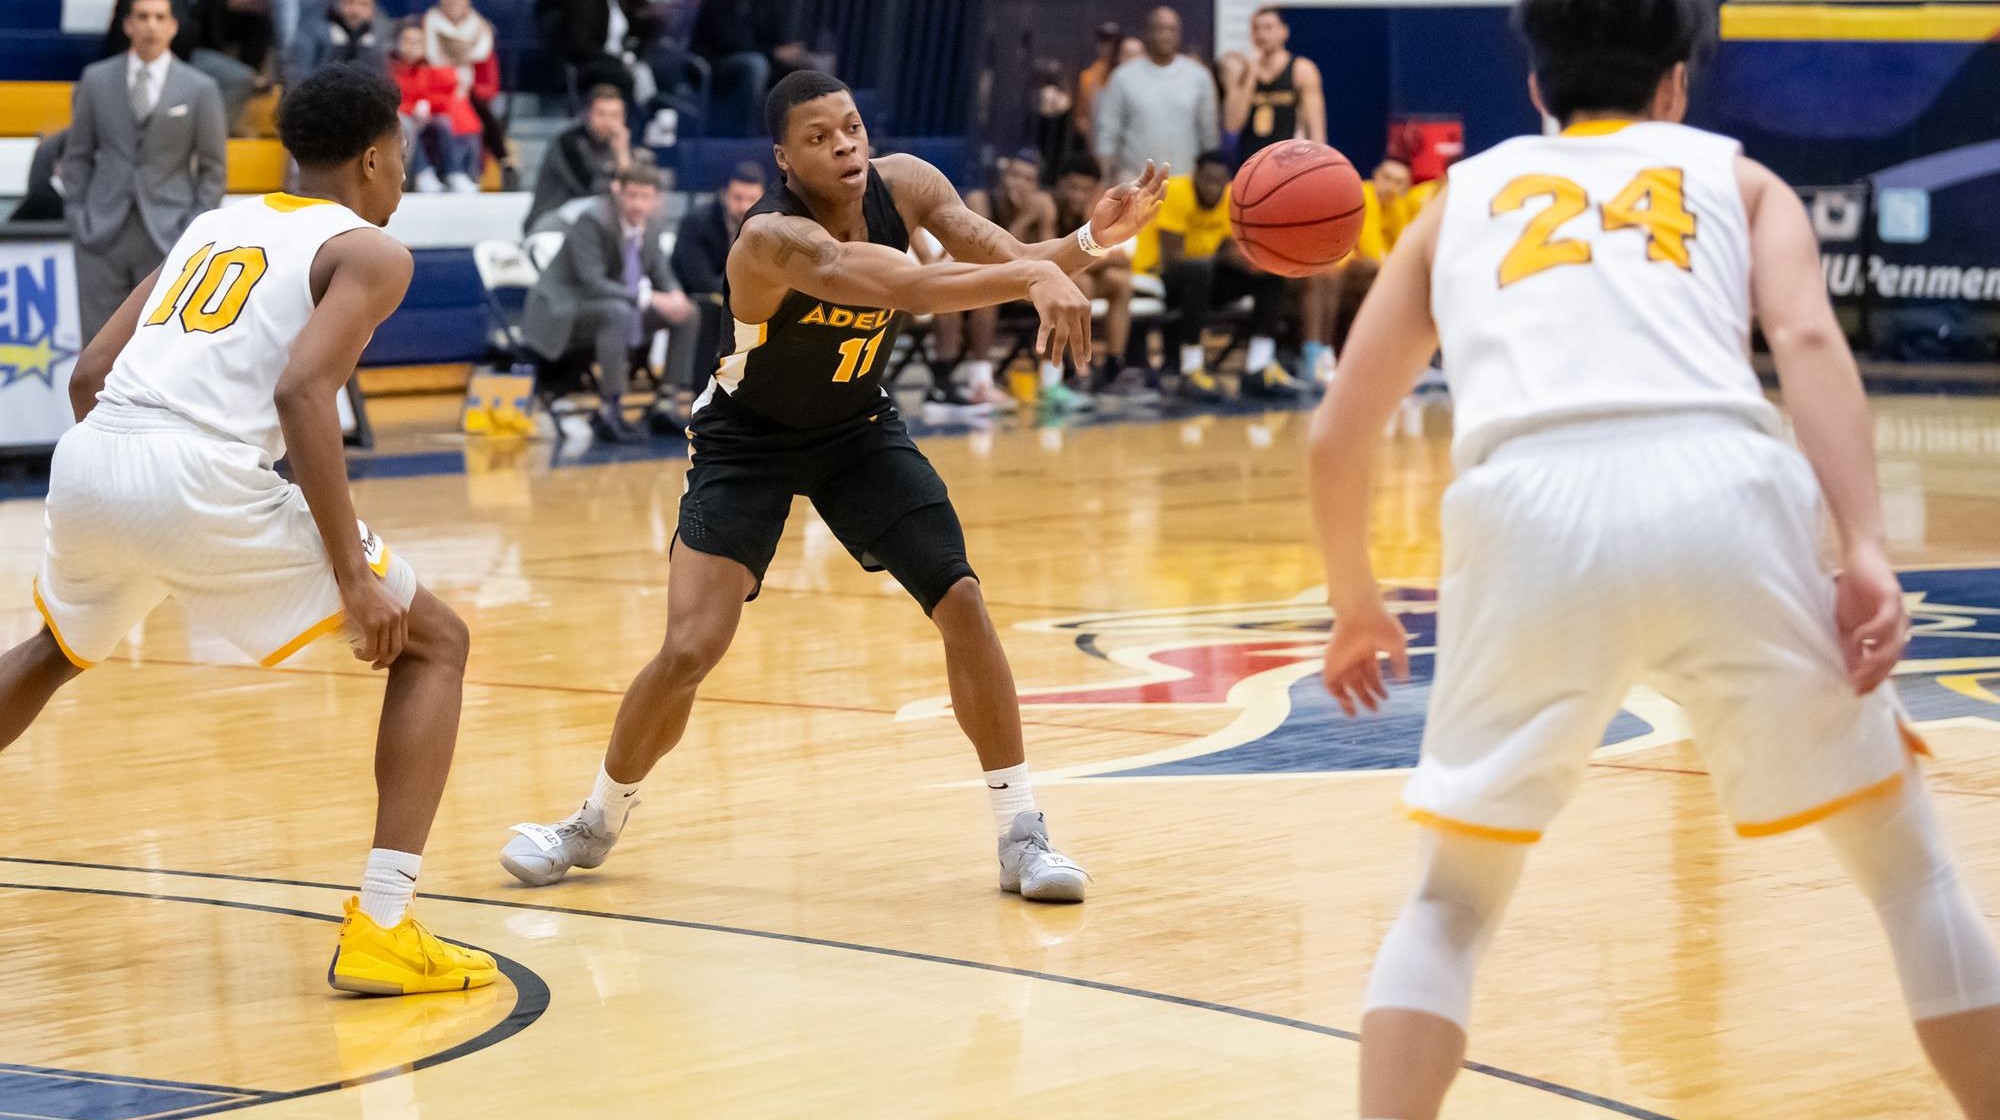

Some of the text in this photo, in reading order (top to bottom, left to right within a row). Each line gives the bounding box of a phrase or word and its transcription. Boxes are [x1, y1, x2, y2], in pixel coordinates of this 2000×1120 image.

[1490, 166, 1697, 288] 24
[143, 241, 268, 334] 10
[797, 302, 896, 331] ADEL
[831, 326, 887, 383] 11
